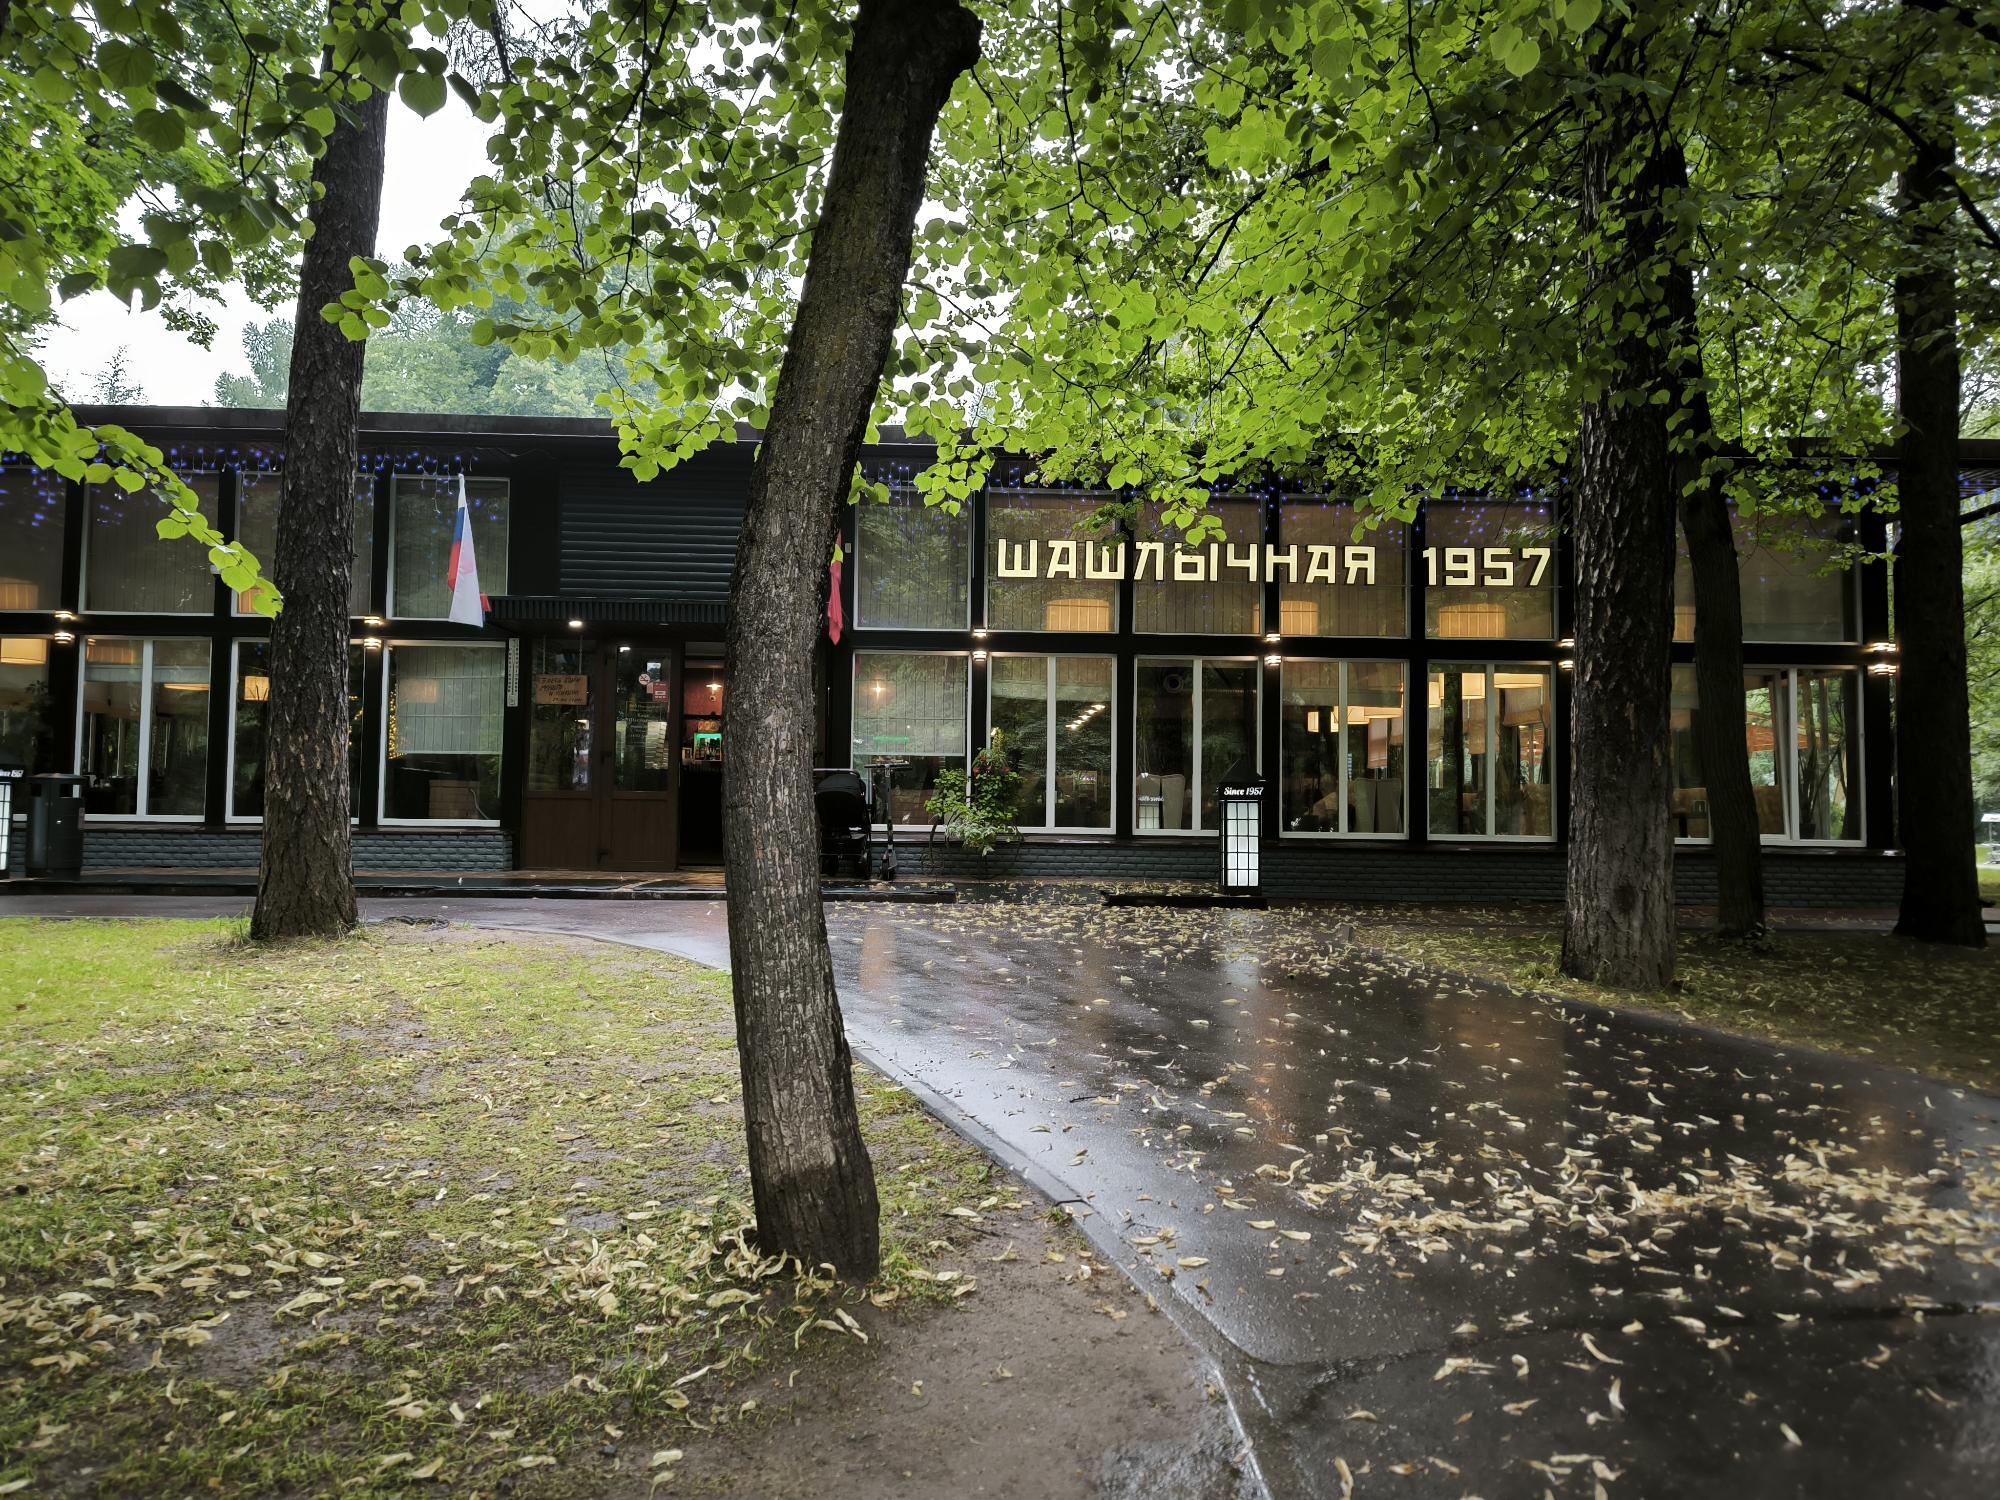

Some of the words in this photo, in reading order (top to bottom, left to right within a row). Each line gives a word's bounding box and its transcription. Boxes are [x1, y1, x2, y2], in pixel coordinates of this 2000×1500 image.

[998, 539, 1375, 584] ШАШЛЫЧНАЯ
[1422, 547, 1550, 585] 1957
[1223, 786, 1245, 796] Since
[1245, 786, 1264, 796] 1957
